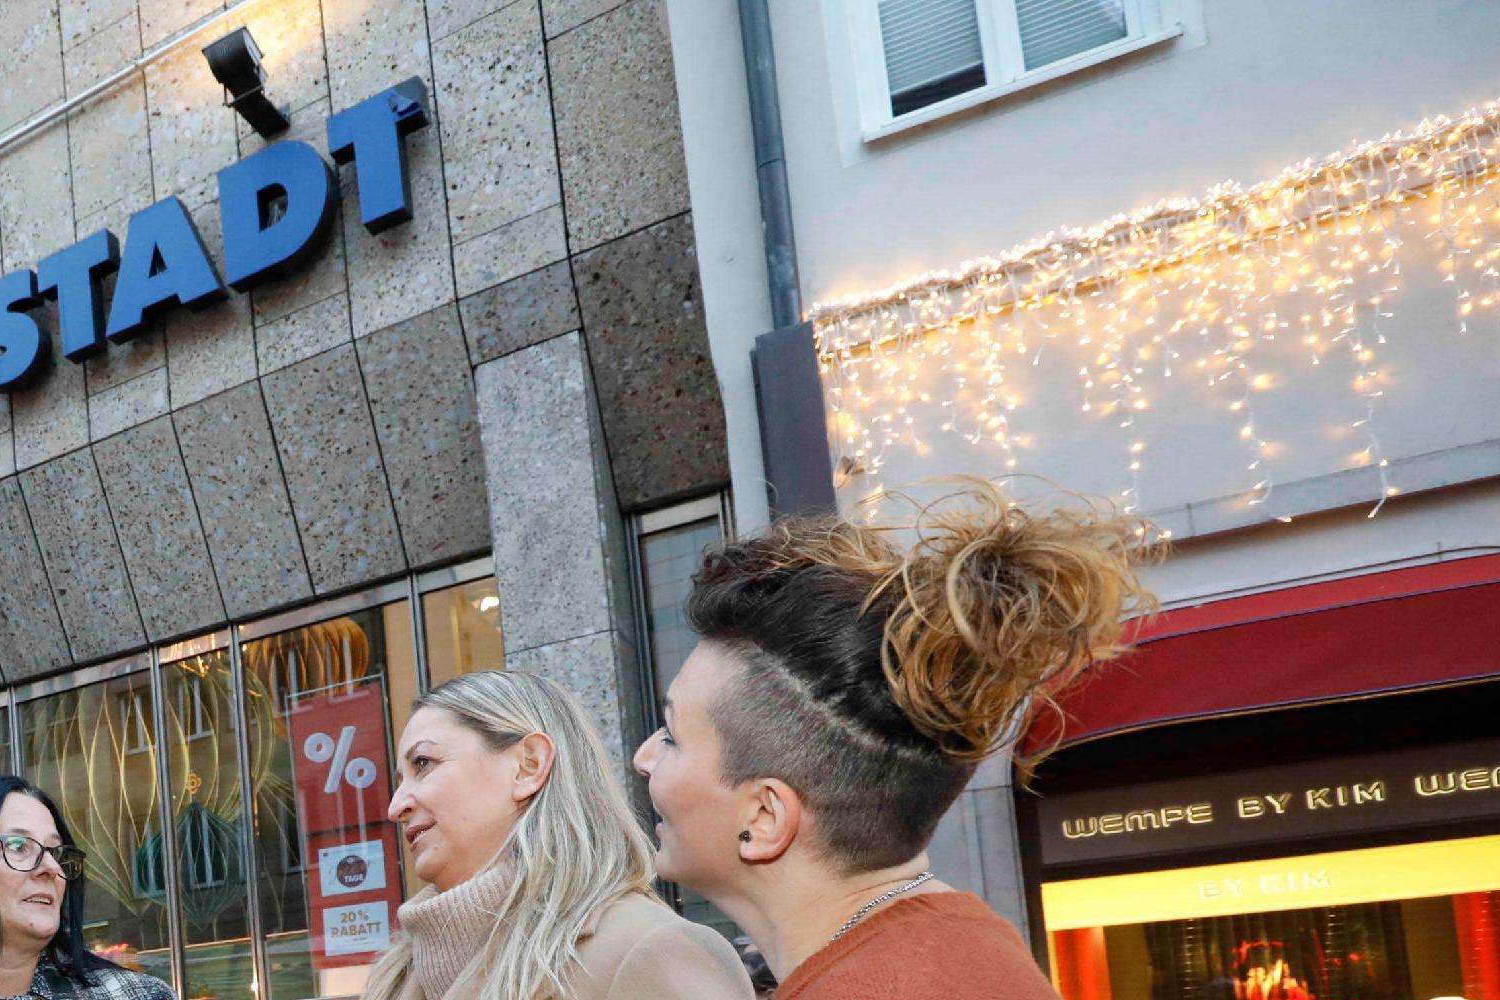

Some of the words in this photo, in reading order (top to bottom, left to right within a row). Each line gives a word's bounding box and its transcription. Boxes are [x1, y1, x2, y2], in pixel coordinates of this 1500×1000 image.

[303, 725, 377, 793] %
[1062, 802, 1213, 838] WEMPE
[1237, 792, 1292, 819] BY
[1305, 780, 1386, 811] KIM
[1414, 767, 1500, 796] WE
[1201, 878, 1244, 898] BY
[1259, 868, 1331, 894] KIM
[331, 921, 382, 939] RABATT
[341, 911, 370, 923] 20%
